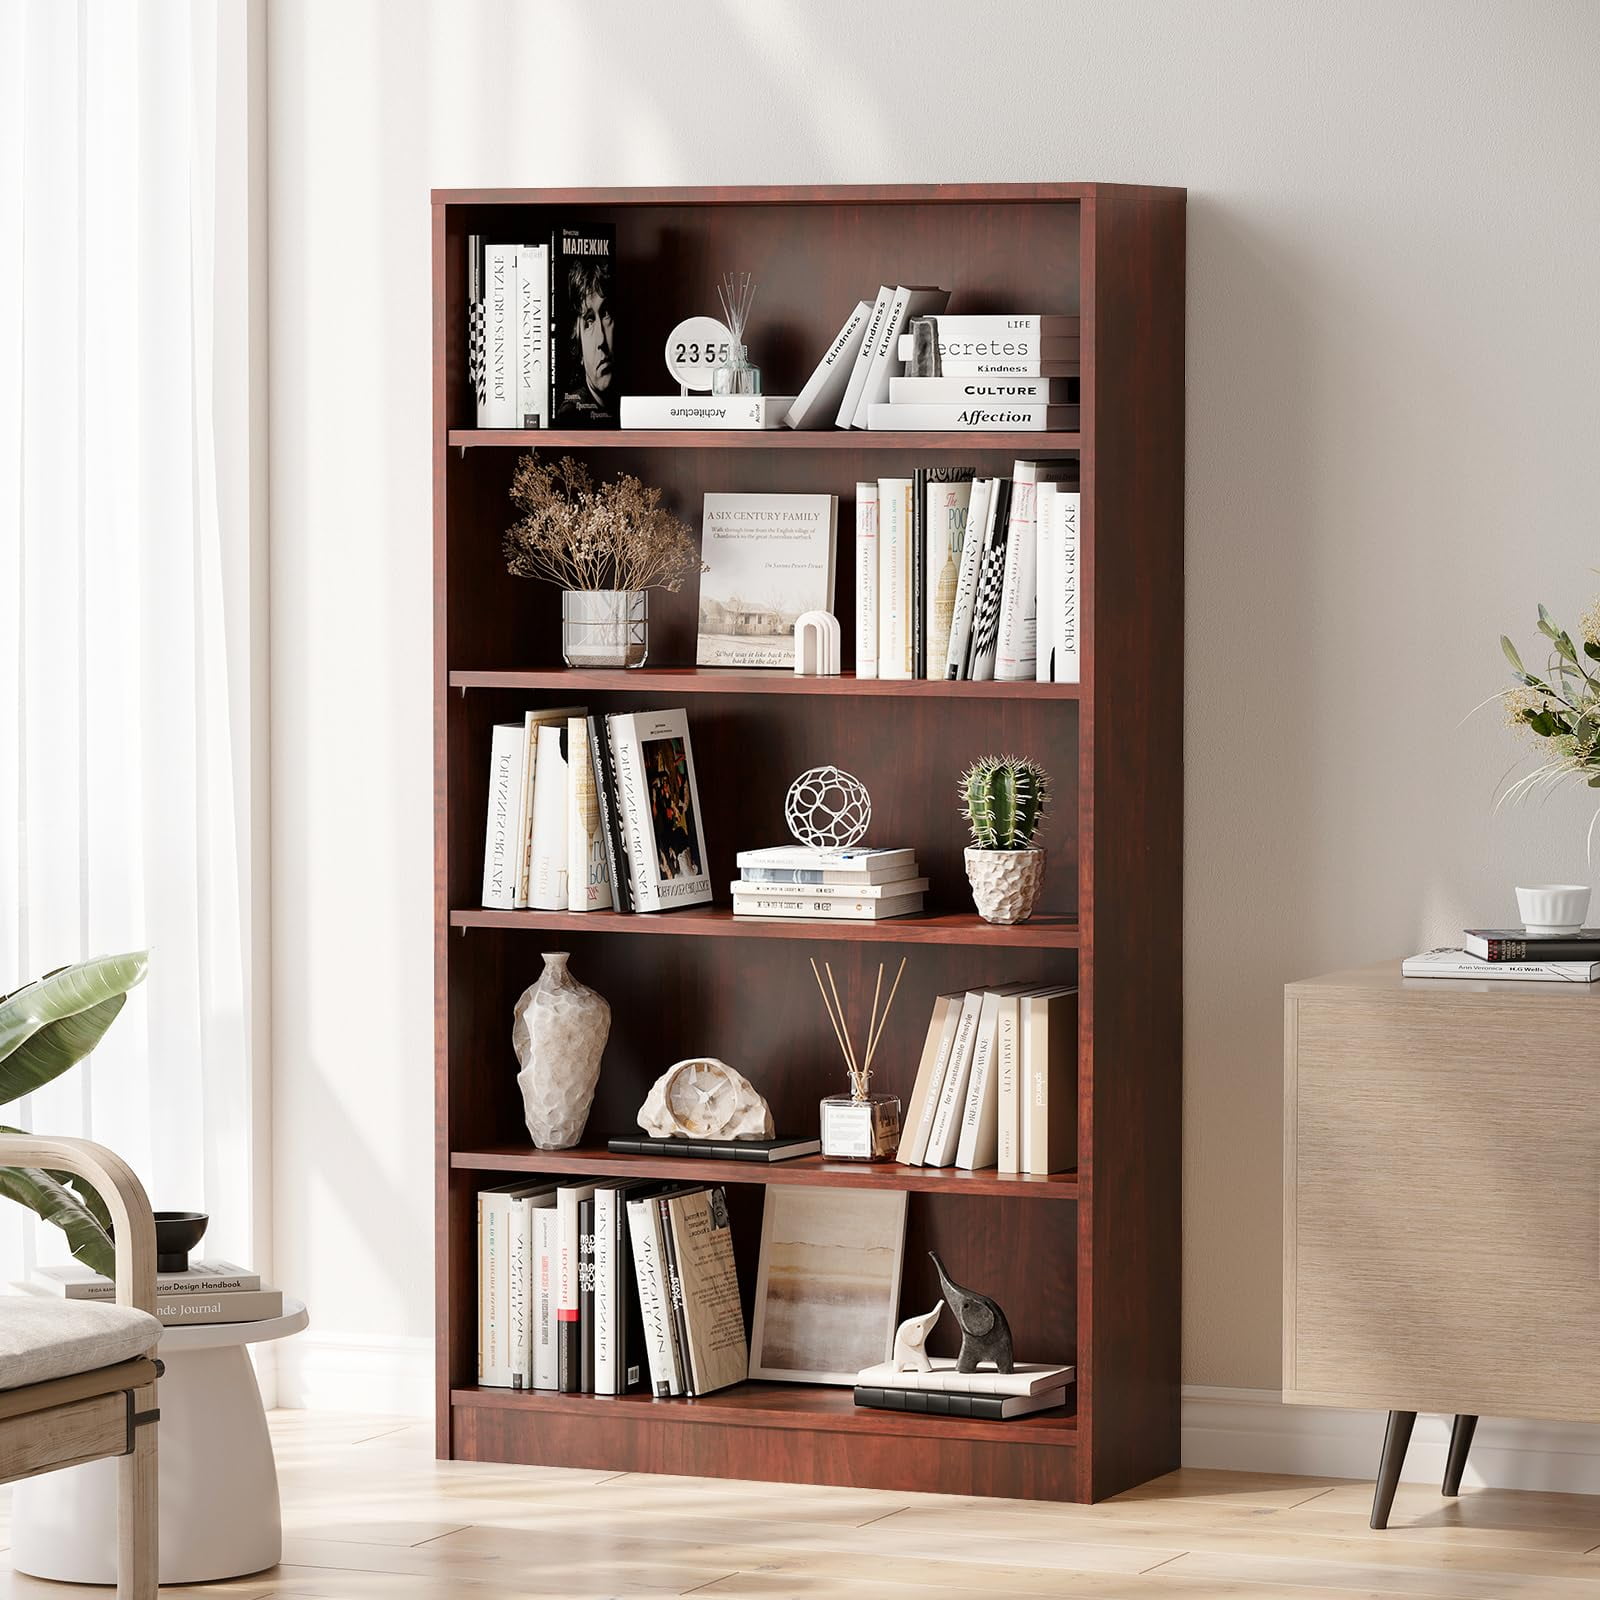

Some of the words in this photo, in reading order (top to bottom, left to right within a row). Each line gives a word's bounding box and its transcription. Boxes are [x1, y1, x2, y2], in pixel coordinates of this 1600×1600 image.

[563, 238, 609, 256] МАЛЕЖИК
[862, 301, 886, 357] Kindness
[878, 301, 902, 357] Kindness
[1007, 320, 1031, 329] LIFE
[825, 316, 861, 366] Kindness
[938, 340, 1029, 356] ecretes
[494, 326, 505, 402] JOHANNES
[977, 365, 1028, 373] Kindness
[964, 385, 1037, 395] CULTURE
[670, 408, 726, 418] Architecture
[957, 410, 1032, 425] Affection
[707, 512, 715, 520] A
[715, 512, 732, 520] SIX
[733, 512, 781, 520] CENTURY
[782, 512, 821, 520] FAMILY
[949, 507, 967, 530] POC
[952, 531, 964, 553] LO
[1064, 576, 1076, 655] JOHANNES
[1004, 1019, 1012, 1033] ON
[944, 1094, 952, 1105] for
[950, 1043, 965, 1087] sustainable
[960, 1013, 973, 1043] lifestyle
[1004, 1039, 1012, 1093] IMMUNITY
[967, 1094, 980, 1126] DREAM
[977, 1038, 989, 1068] AWAKE
[173, 1283, 200, 1292] Design
[201, 1280, 242, 1289] Handbook
[157, 1305, 177, 1316] nde
[179, 1302, 221, 1316] Journal
